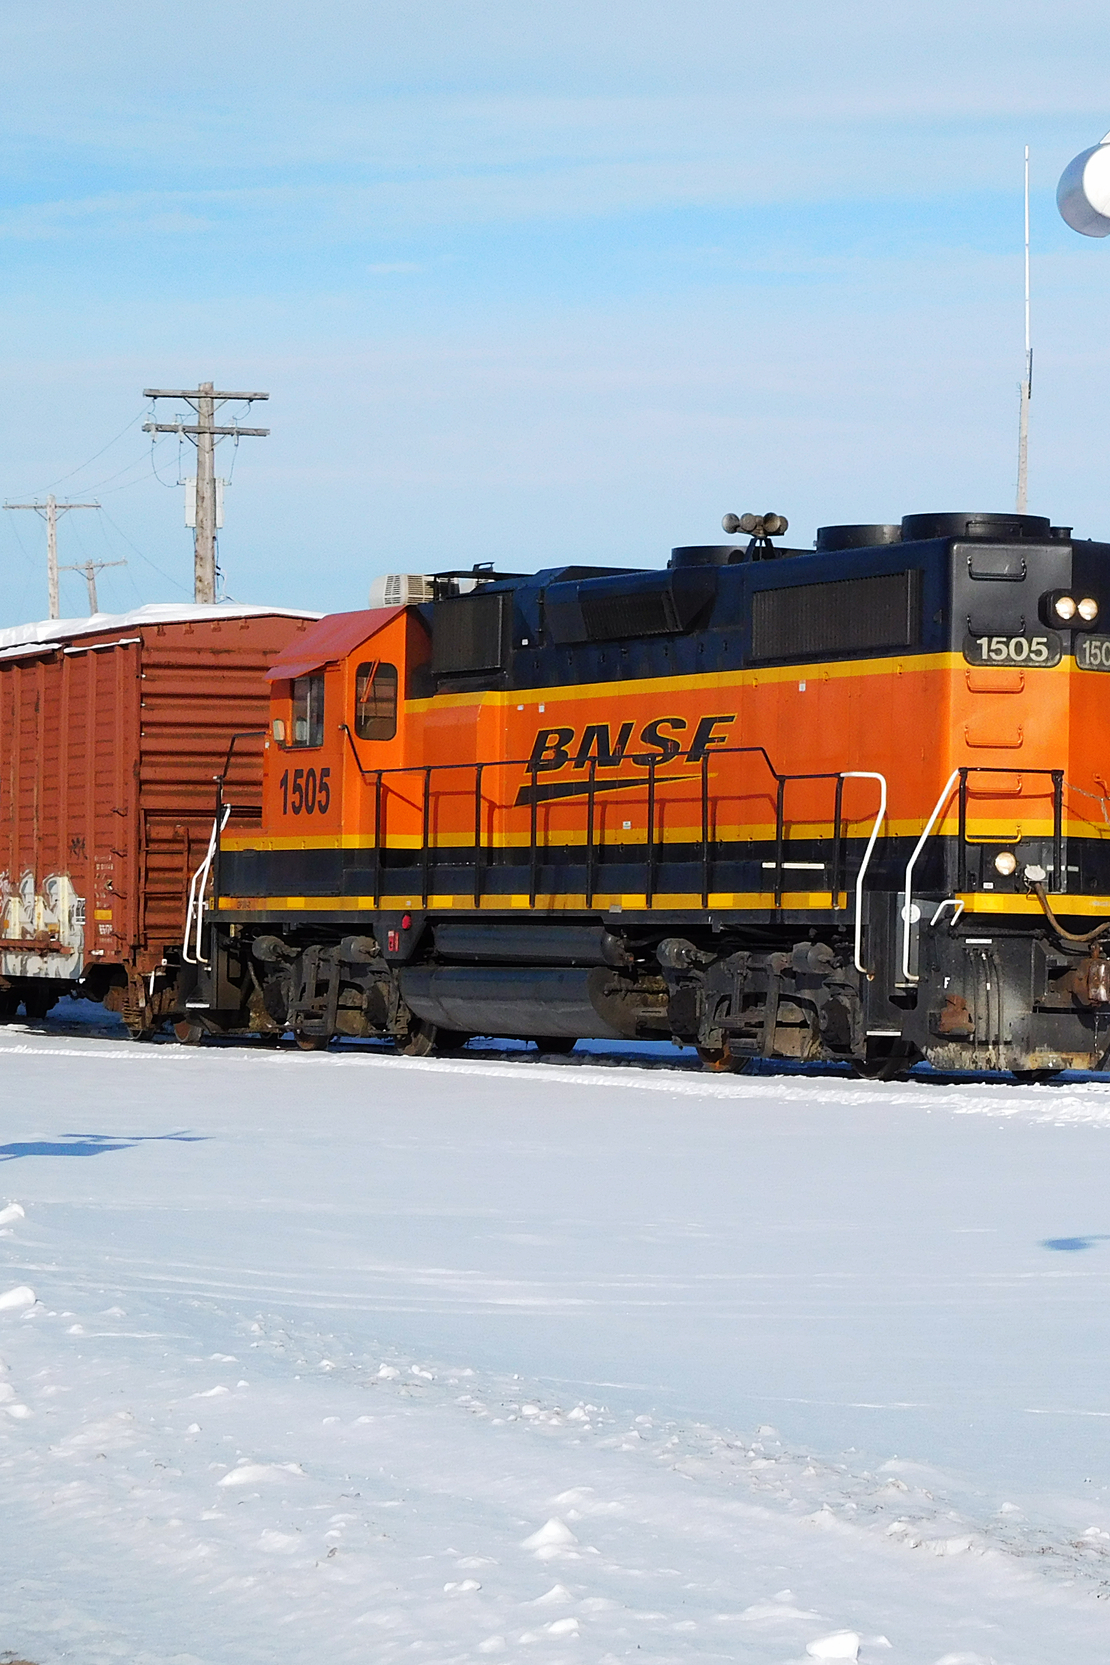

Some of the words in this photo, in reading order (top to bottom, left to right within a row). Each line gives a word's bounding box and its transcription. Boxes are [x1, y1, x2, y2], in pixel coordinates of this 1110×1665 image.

[976, 636, 1049, 662] 1505
[524, 712, 739, 776] BNSF
[279, 767, 331, 816] 1505
